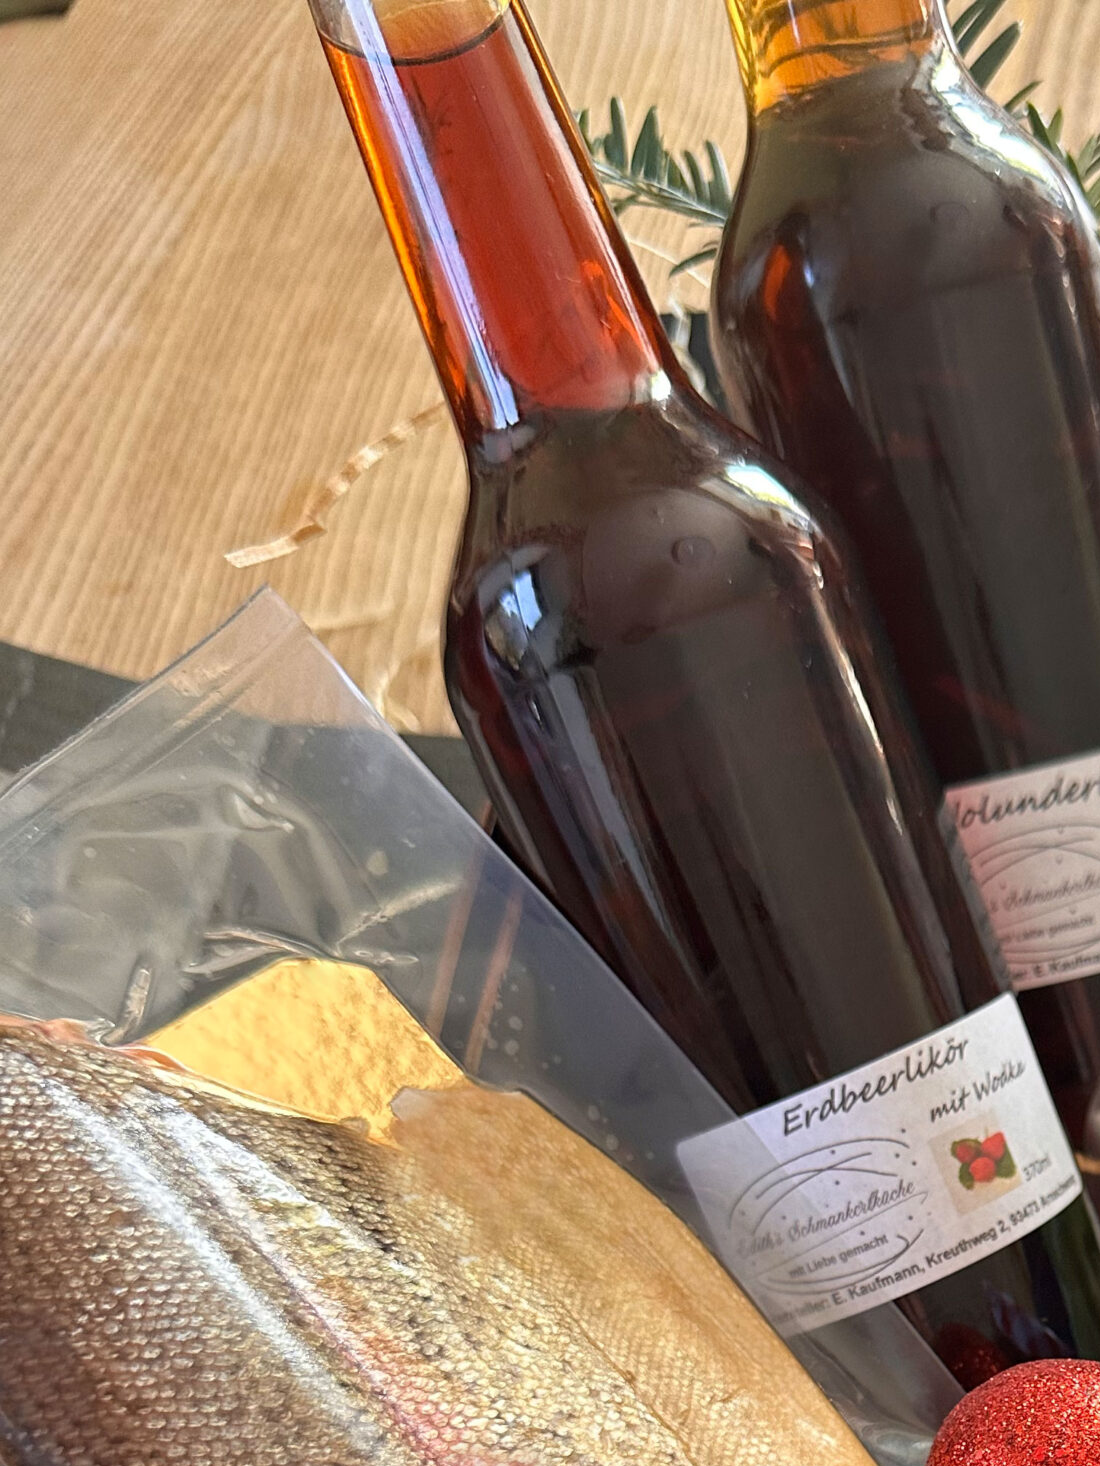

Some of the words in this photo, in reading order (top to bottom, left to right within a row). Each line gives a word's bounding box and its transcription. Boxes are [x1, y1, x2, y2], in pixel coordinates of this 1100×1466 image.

[783, 1036, 970, 1136] Erdbeerlikör
[930, 1088, 971, 1123] mit
[806, 1255, 838, 1274] Liebe
[838, 1233, 889, 1263] gemacht
[830, 1291, 848, 1307] E.
[848, 1262, 927, 1299] Kaufmann,
[925, 1225, 998, 1267] Kreuthweg
[997, 1219, 1011, 1234] 2,
